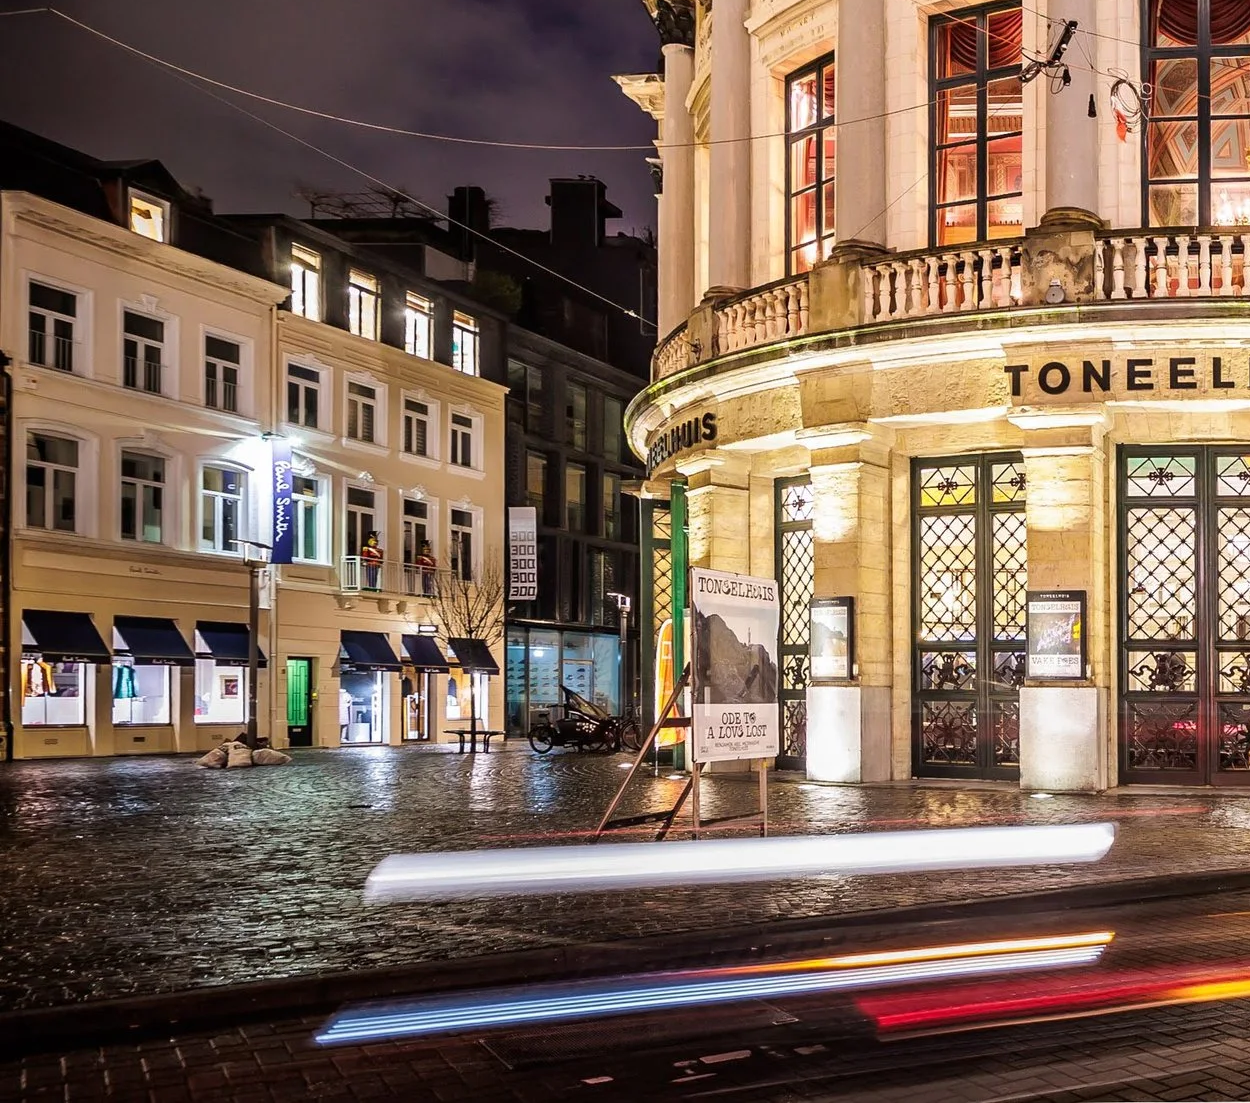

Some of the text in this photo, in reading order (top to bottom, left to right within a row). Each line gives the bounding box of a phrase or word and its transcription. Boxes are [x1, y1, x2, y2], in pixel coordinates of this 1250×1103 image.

[274, 460, 291, 542] Paul Smith
[511, 545, 535, 555] 300
[511, 559, 536, 569] 300
[511, 572, 536, 583] 300
[511, 586, 536, 596] 300
[721, 712, 756, 725] ODE TO
[707, 726, 715, 739] A
[746, 725, 767, 737] LOST
